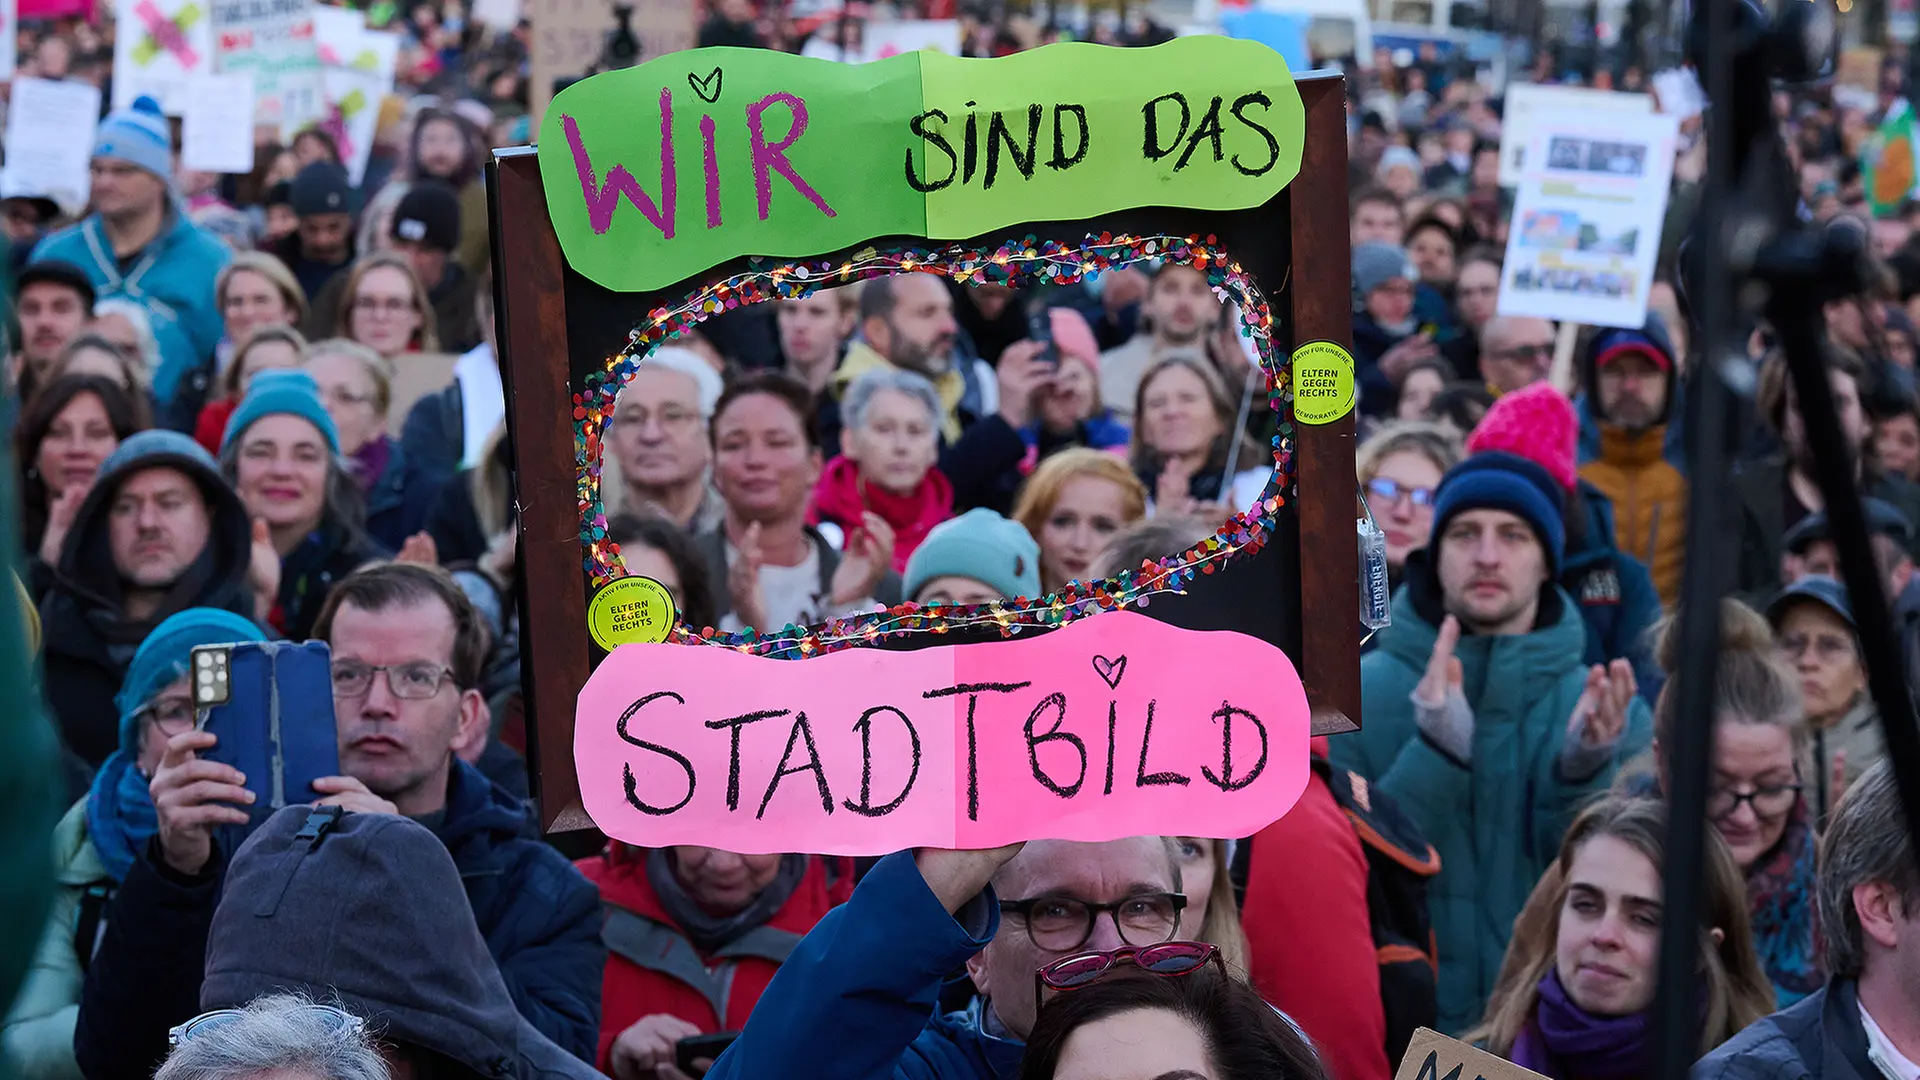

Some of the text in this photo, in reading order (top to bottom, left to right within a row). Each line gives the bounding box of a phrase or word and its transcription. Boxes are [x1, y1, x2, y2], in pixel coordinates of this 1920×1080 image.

[558, 67, 1281, 240] WIR SIND DAS
[1293, 349, 1310, 363] AKTIV
[1325, 347, 1350, 365] UNSERE
[1301, 369, 1338, 378] ELTERN
[1302, 379, 1336, 387] GEGEN
[1299, 389, 1338, 397] RECHTS
[1295, 408, 1339, 420] DEMOKRATIE
[598, 582, 657, 602] AKTIV FÜR UNSERE
[610, 600, 649, 614] ELTERN
[613, 609, 649, 623] GEGEN
[612, 618, 653, 632] RECHTS
[616, 655, 1269, 822] STADTBILD
